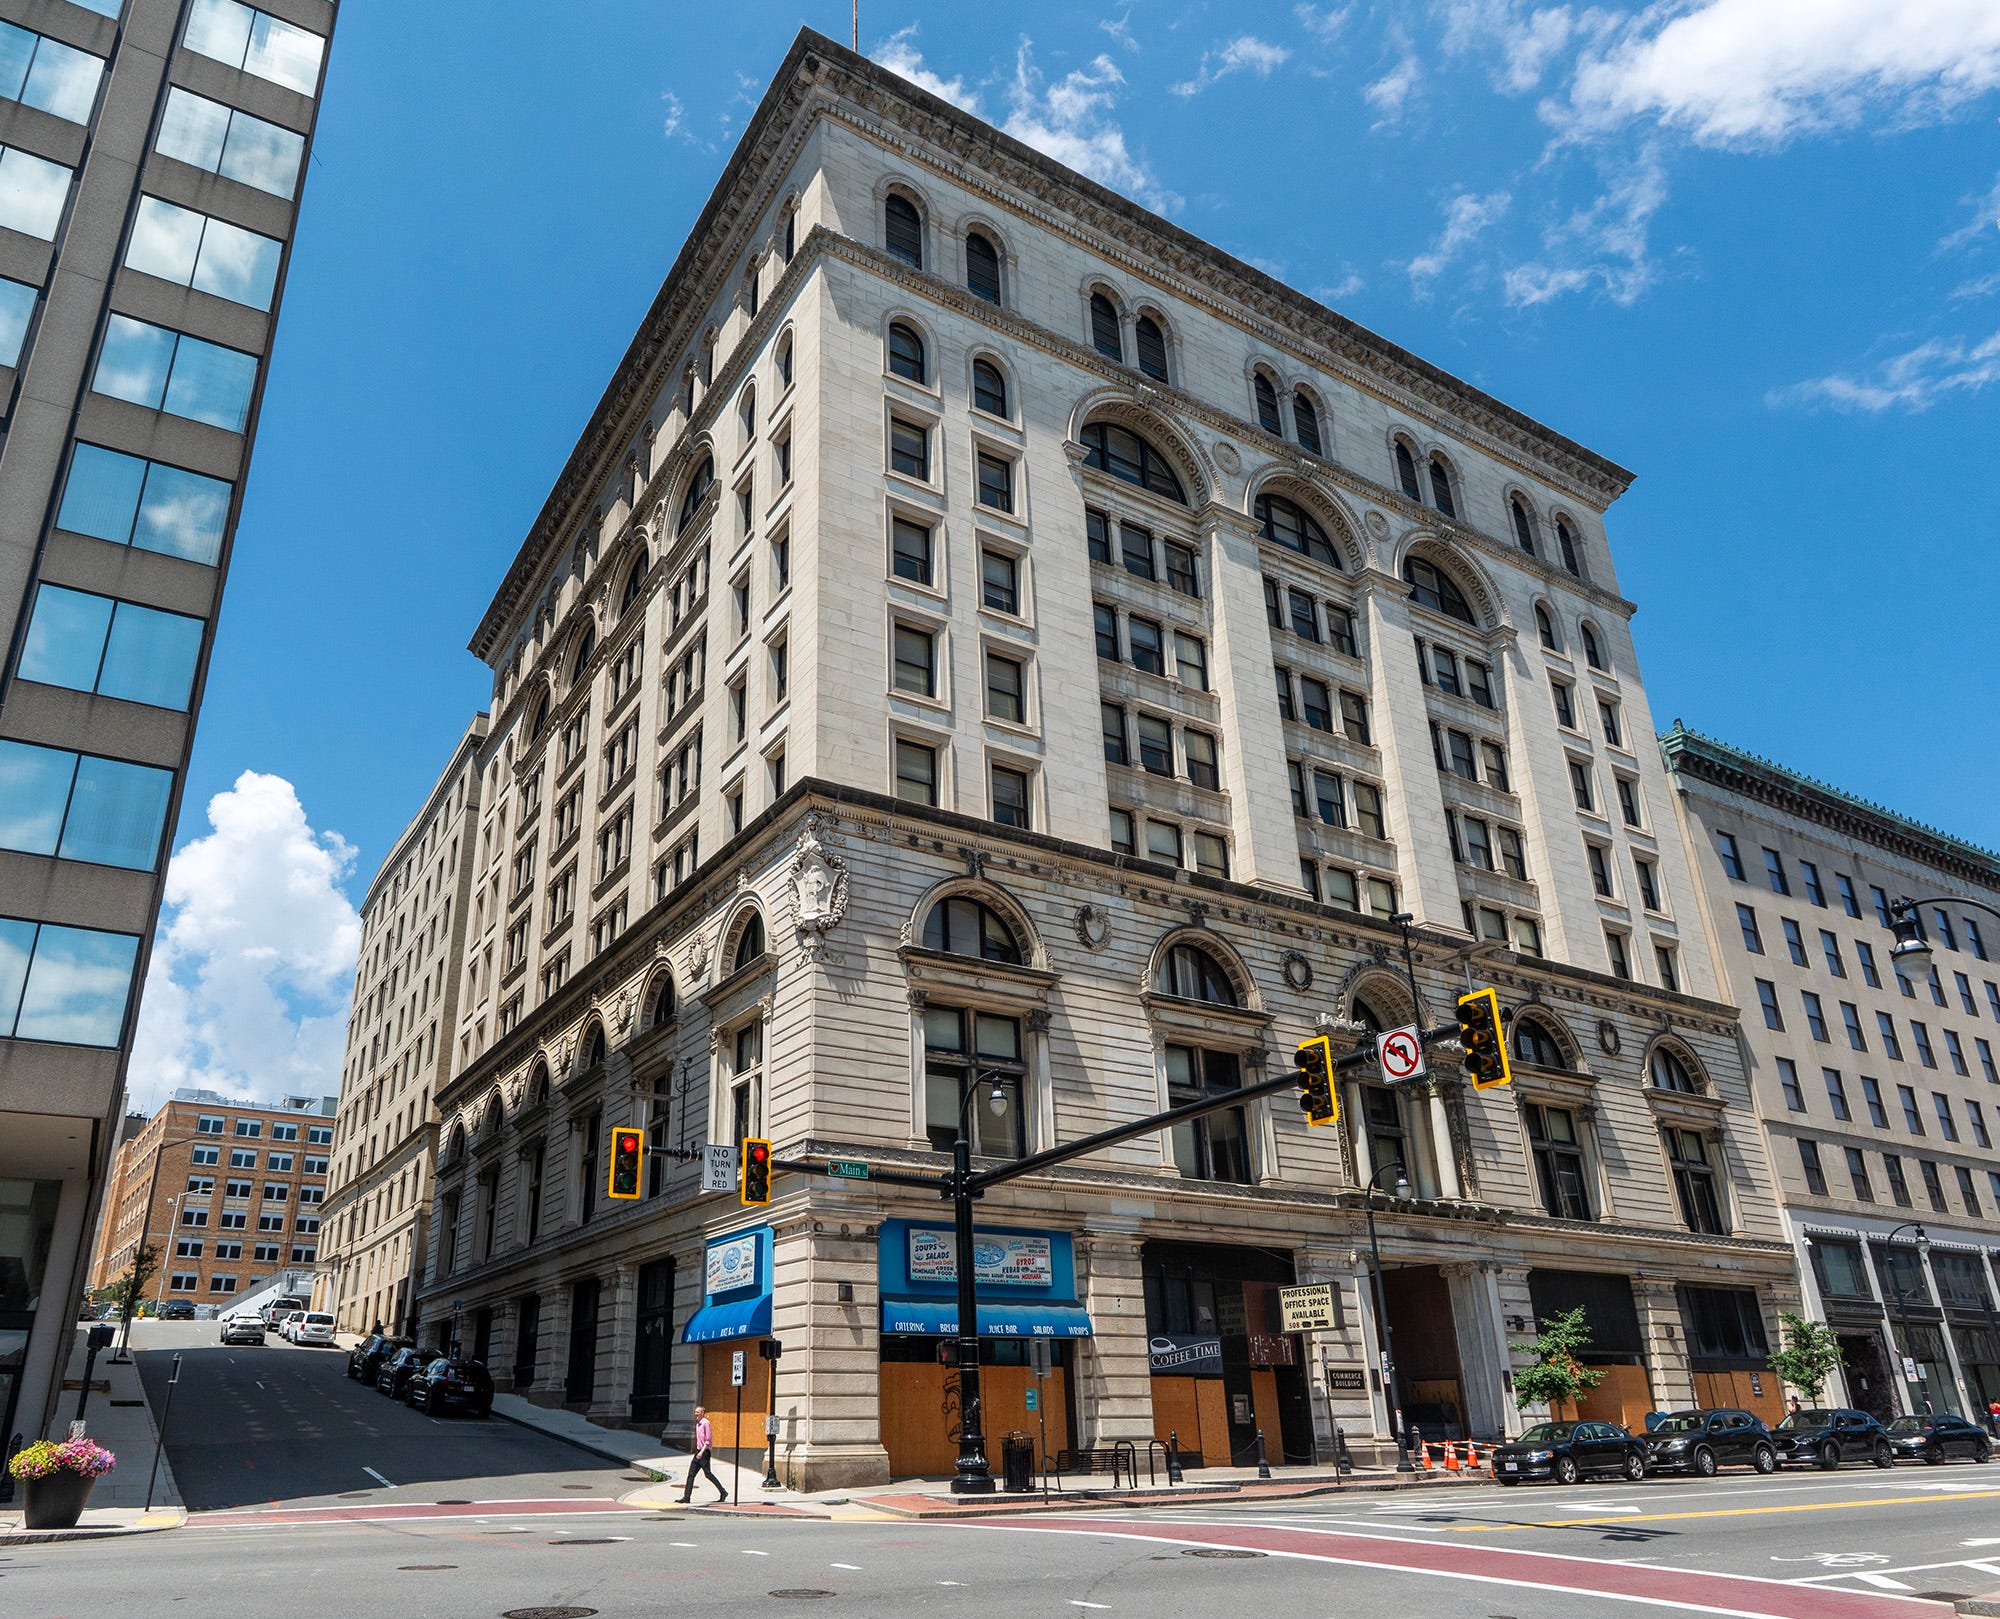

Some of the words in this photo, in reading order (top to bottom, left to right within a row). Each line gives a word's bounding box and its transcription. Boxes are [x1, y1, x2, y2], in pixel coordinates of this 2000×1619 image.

[713, 1149, 729, 1158] NO
[710, 1160, 731, 1168] TURN
[714, 1170, 726, 1178] ON
[840, 1163, 860, 1176] Main
[712, 1180, 728, 1188] RED
[915, 1243, 938, 1252] SOUPS
[925, 1251, 950, 1260] SALADS
[1015, 1258, 1035, 1266] GYROS
[1282, 1286, 1330, 1299] PROFESSIONAL
[1284, 1300, 1307, 1310] OFFICE
[1309, 1297, 1330, 1307] SPACE
[1292, 1309, 1325, 1320] AVAILABLE
[895, 1321, 926, 1332] CATERING
[940, 1323, 959, 1333] BREAK
[988, 1324, 1004, 1334] JUICE
[1005, 1324, 1018, 1334] BAR
[1033, 1325, 1055, 1335] SALADS
[1068, 1326, 1089, 1336] WRAPS
[1151, 1350, 1190, 1367] COFFEE
[1193, 1344, 1219, 1358] TIME
[1332, 1372, 1362, 1380] COMMERCE
